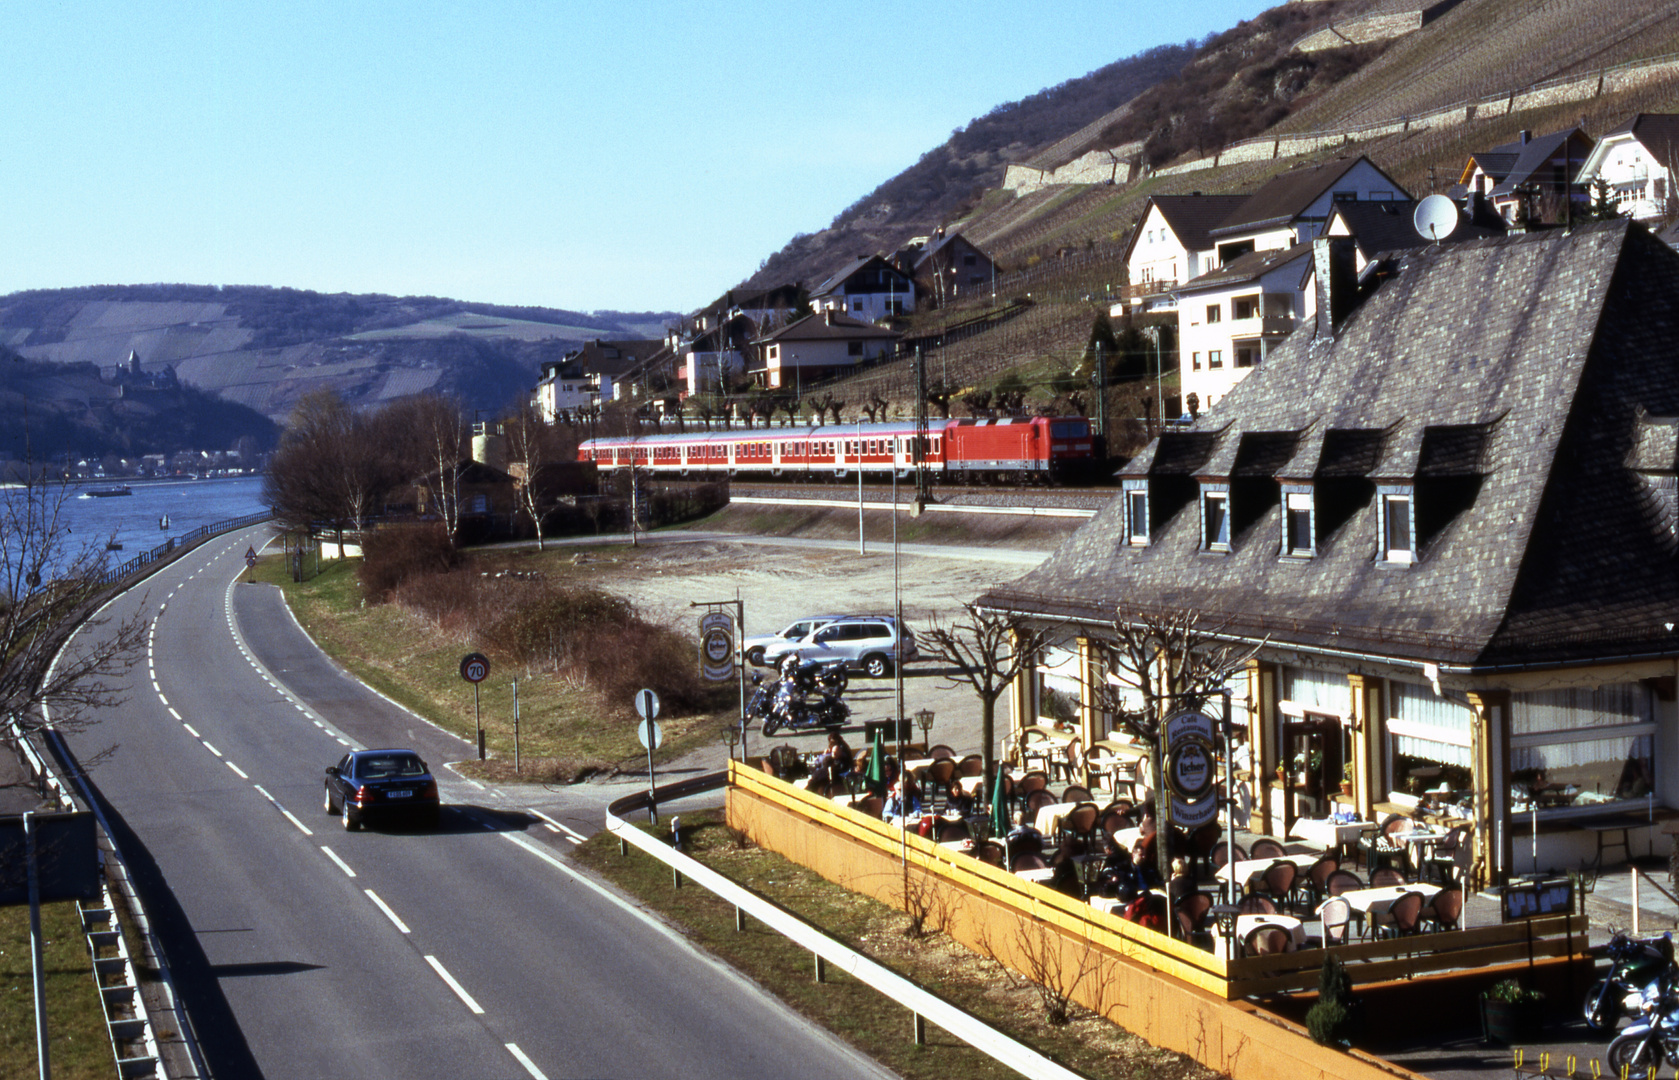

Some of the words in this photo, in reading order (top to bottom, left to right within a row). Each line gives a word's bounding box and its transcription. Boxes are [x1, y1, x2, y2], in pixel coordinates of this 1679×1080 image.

[470, 666, 483, 677] 70
[1181, 715, 1198, 724] Café
[1171, 725, 1209, 739] Restaurant
[1180, 761, 1205, 776] Licher
[1174, 804, 1215, 821] Winzerhaus
